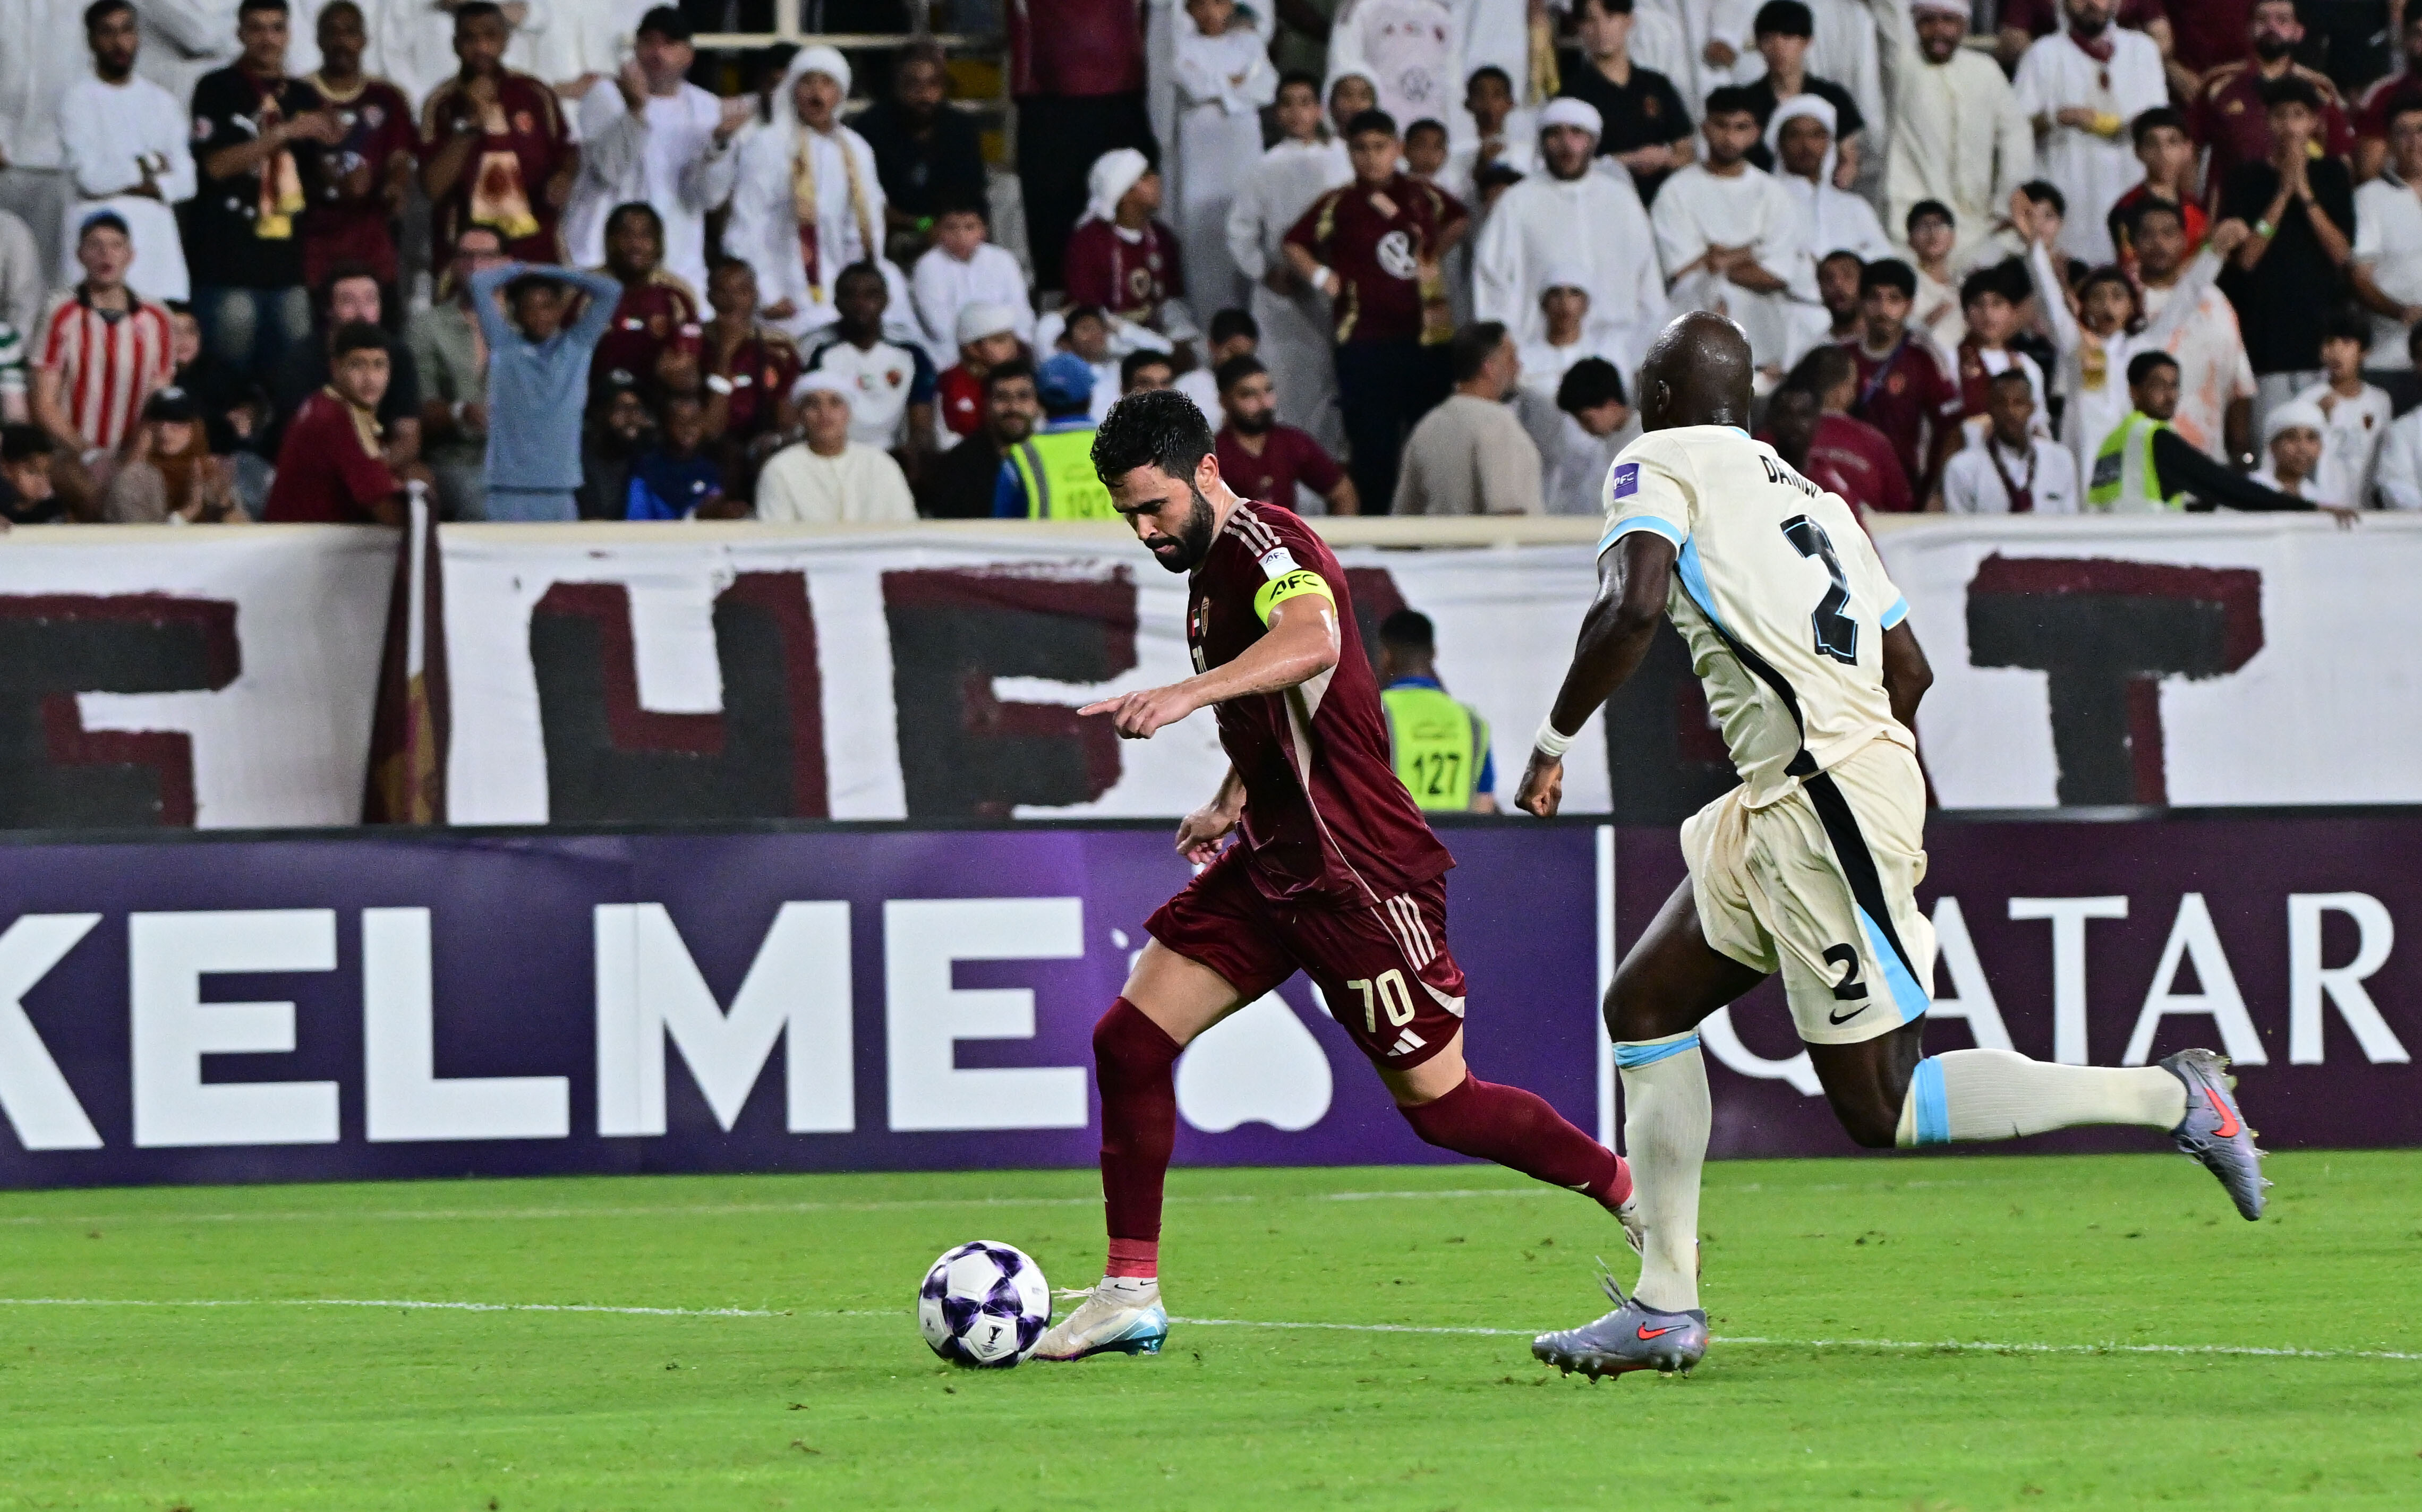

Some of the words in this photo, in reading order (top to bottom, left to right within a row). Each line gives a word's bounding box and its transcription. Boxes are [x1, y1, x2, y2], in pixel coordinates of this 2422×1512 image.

[1265, 552, 1288, 564] AFC
[1269, 574, 1319, 602] AFC
[1780, 514, 1858, 667] 2
[1412, 751, 1461, 796] 127
[1822, 943, 1869, 1001] 2
[1346, 969, 1415, 1033] 70
